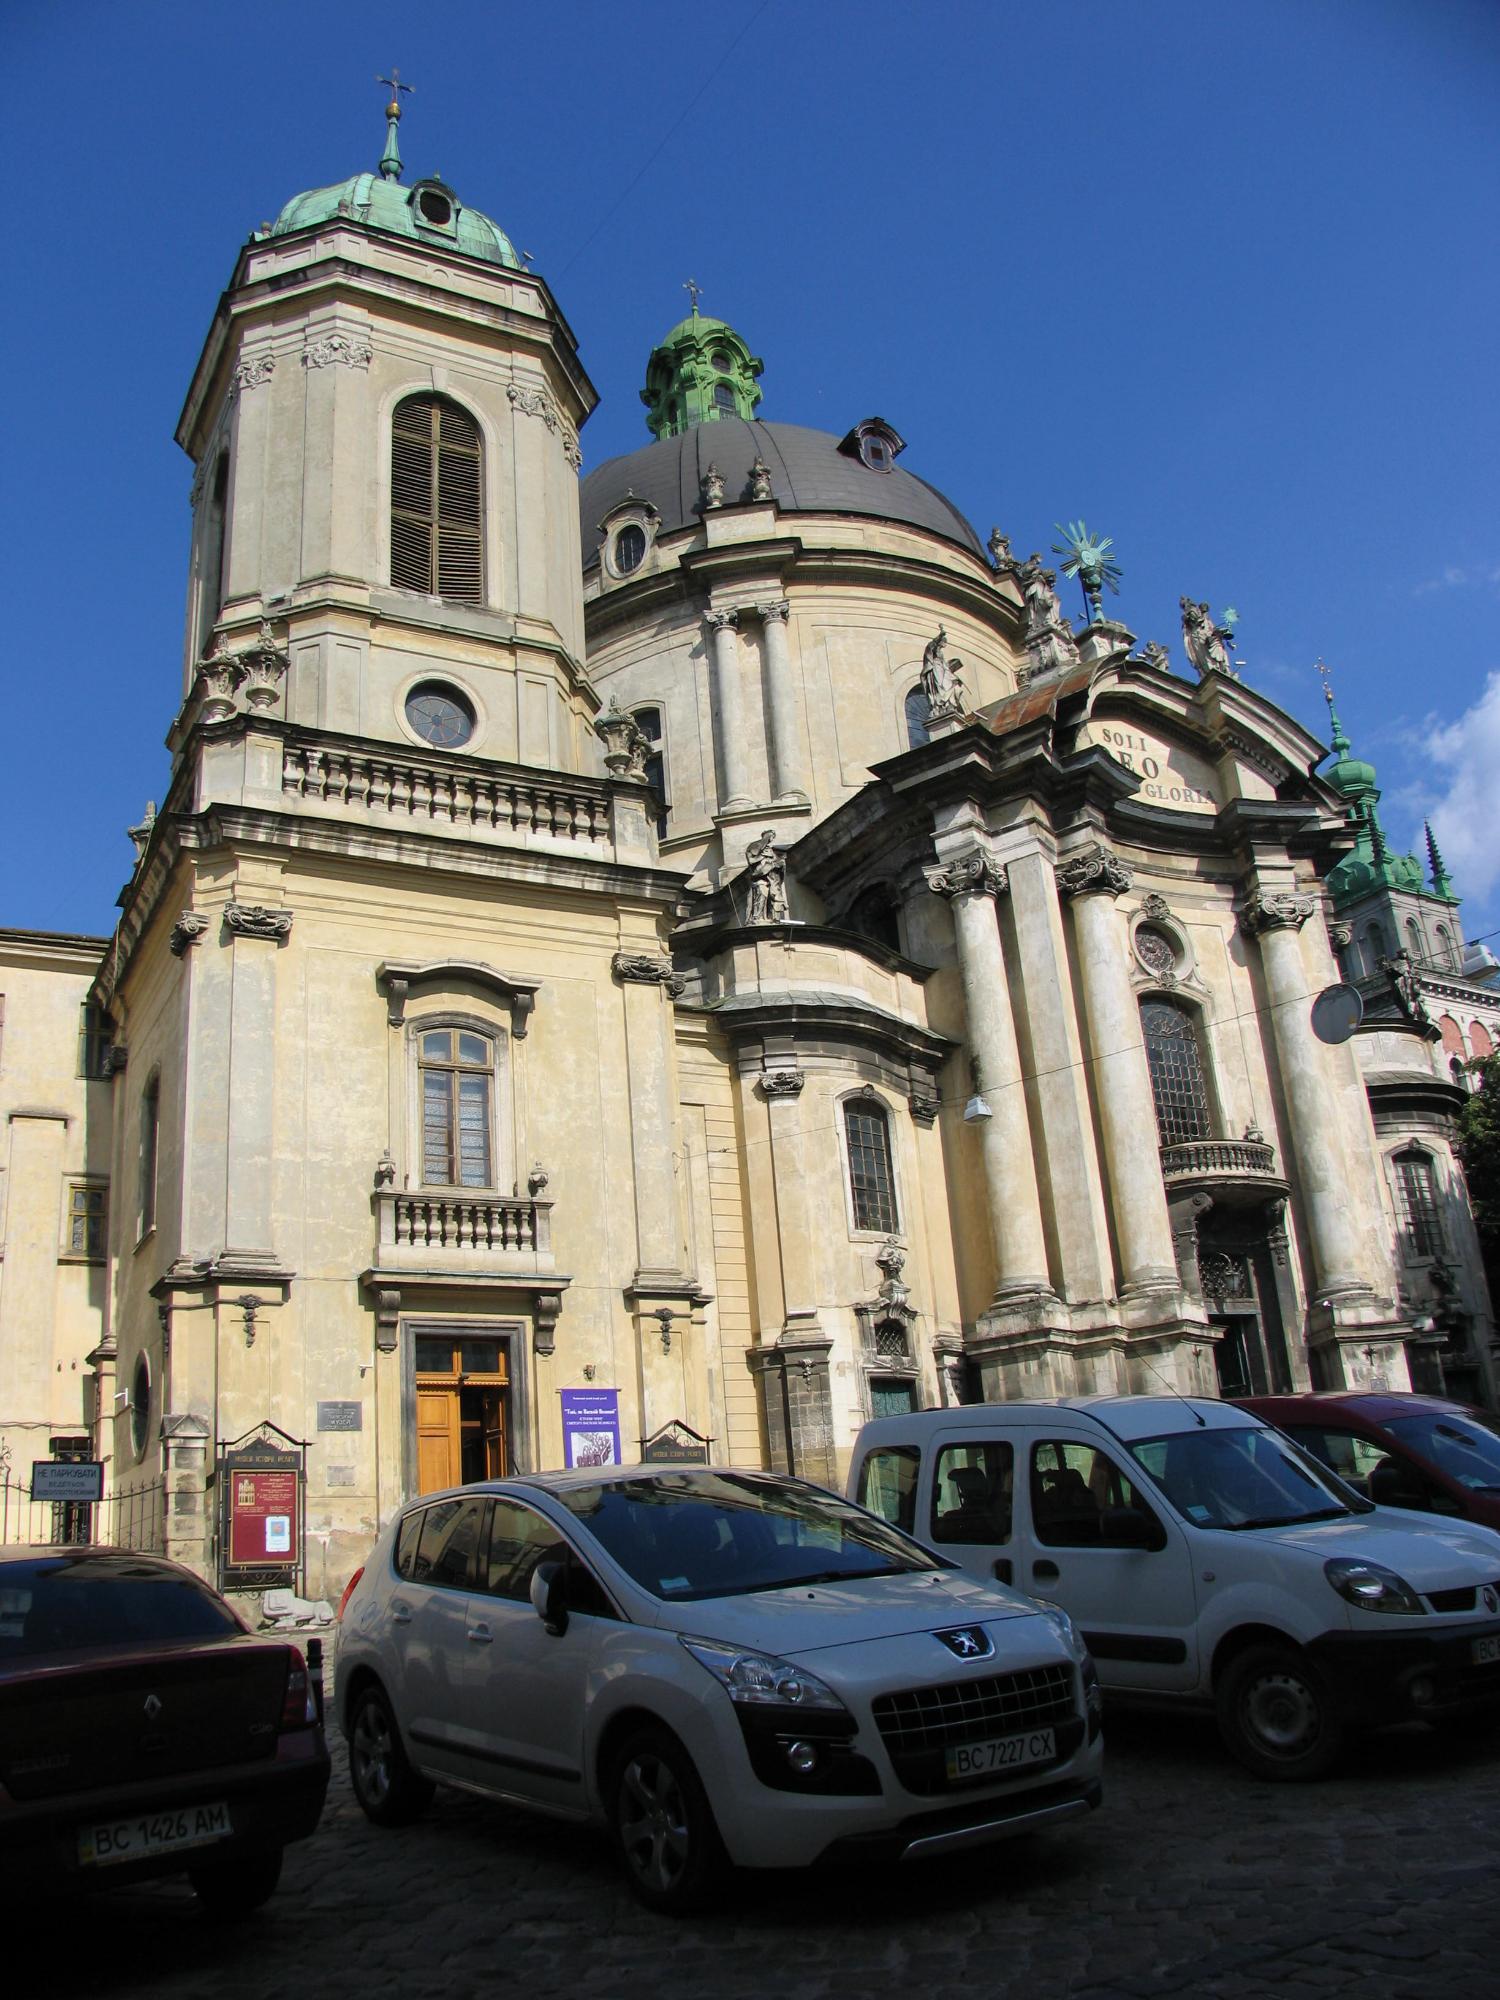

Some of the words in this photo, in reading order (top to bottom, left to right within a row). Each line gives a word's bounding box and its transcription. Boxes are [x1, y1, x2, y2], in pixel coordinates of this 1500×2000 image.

[1102, 728, 1147, 752] SOLI
[1145, 784, 1216, 805] GLORIA
[37, 1468, 49, 1478] НЕ
[50, 1468, 97, 1478] ПАРКУВАТИ
[957, 1747, 985, 1772] BC
[987, 1738, 1025, 1767] 7227
[1029, 1731, 1053, 1758] CX
[95, 1824, 131, 1855] BC
[138, 1812, 188, 1847] 1426
[194, 1806, 226, 1835] AM
